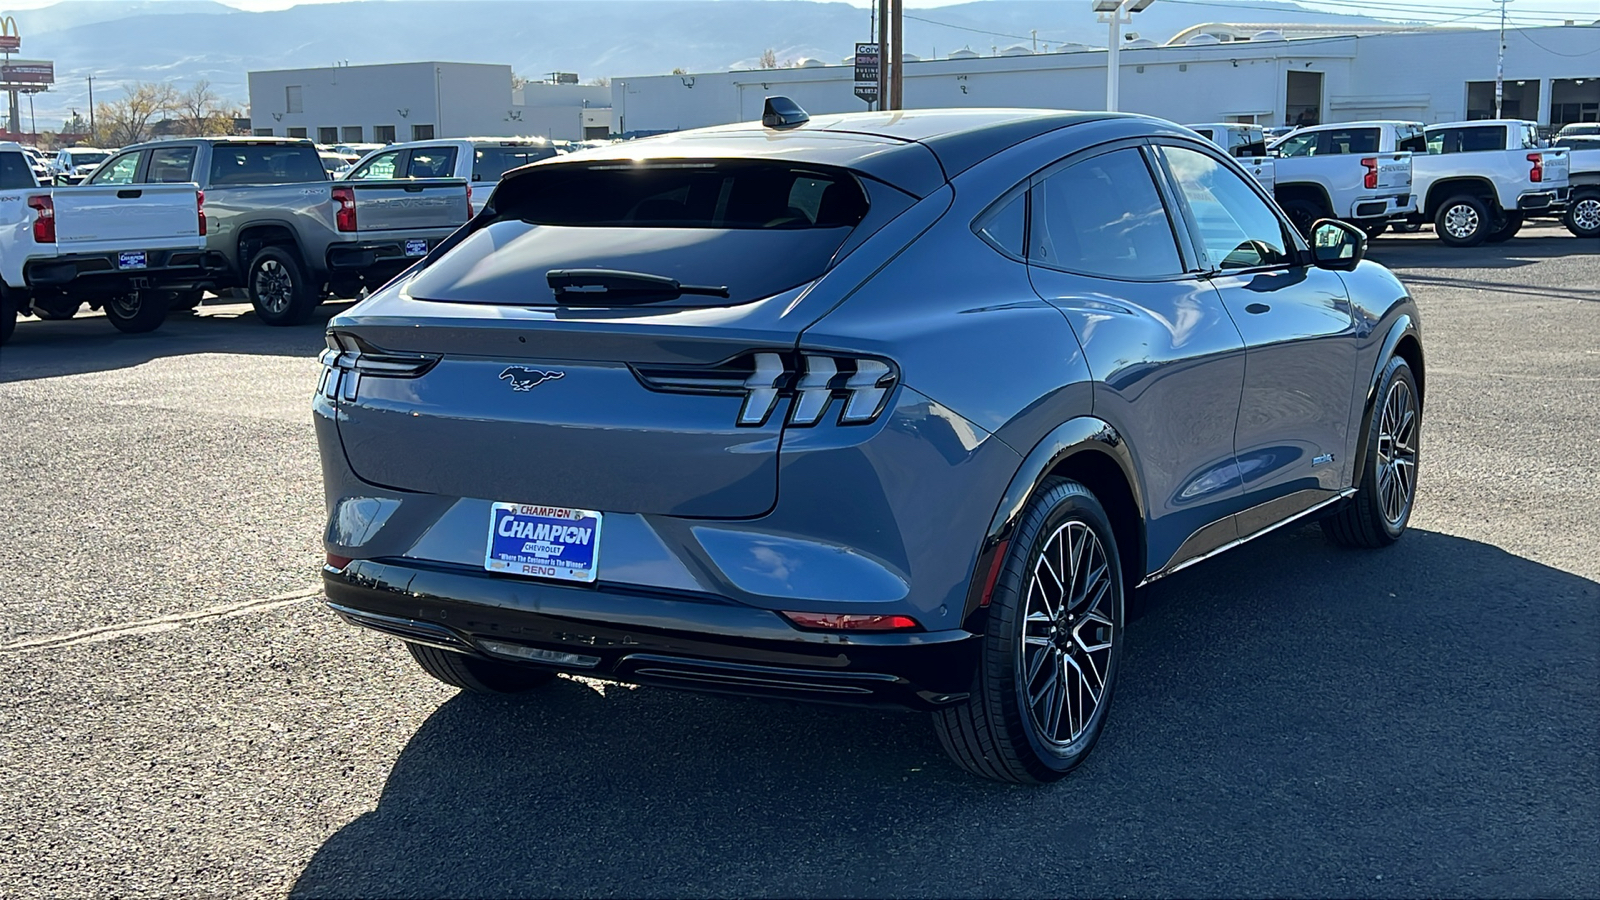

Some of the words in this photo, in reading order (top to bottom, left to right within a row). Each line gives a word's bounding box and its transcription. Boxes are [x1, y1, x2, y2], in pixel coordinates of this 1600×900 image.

[520, 505, 571, 518] CHAMPION
[498, 515, 592, 545] CHAMPION
[525, 543, 561, 554] CHEVROLET
[522, 564, 556, 576] RENO
